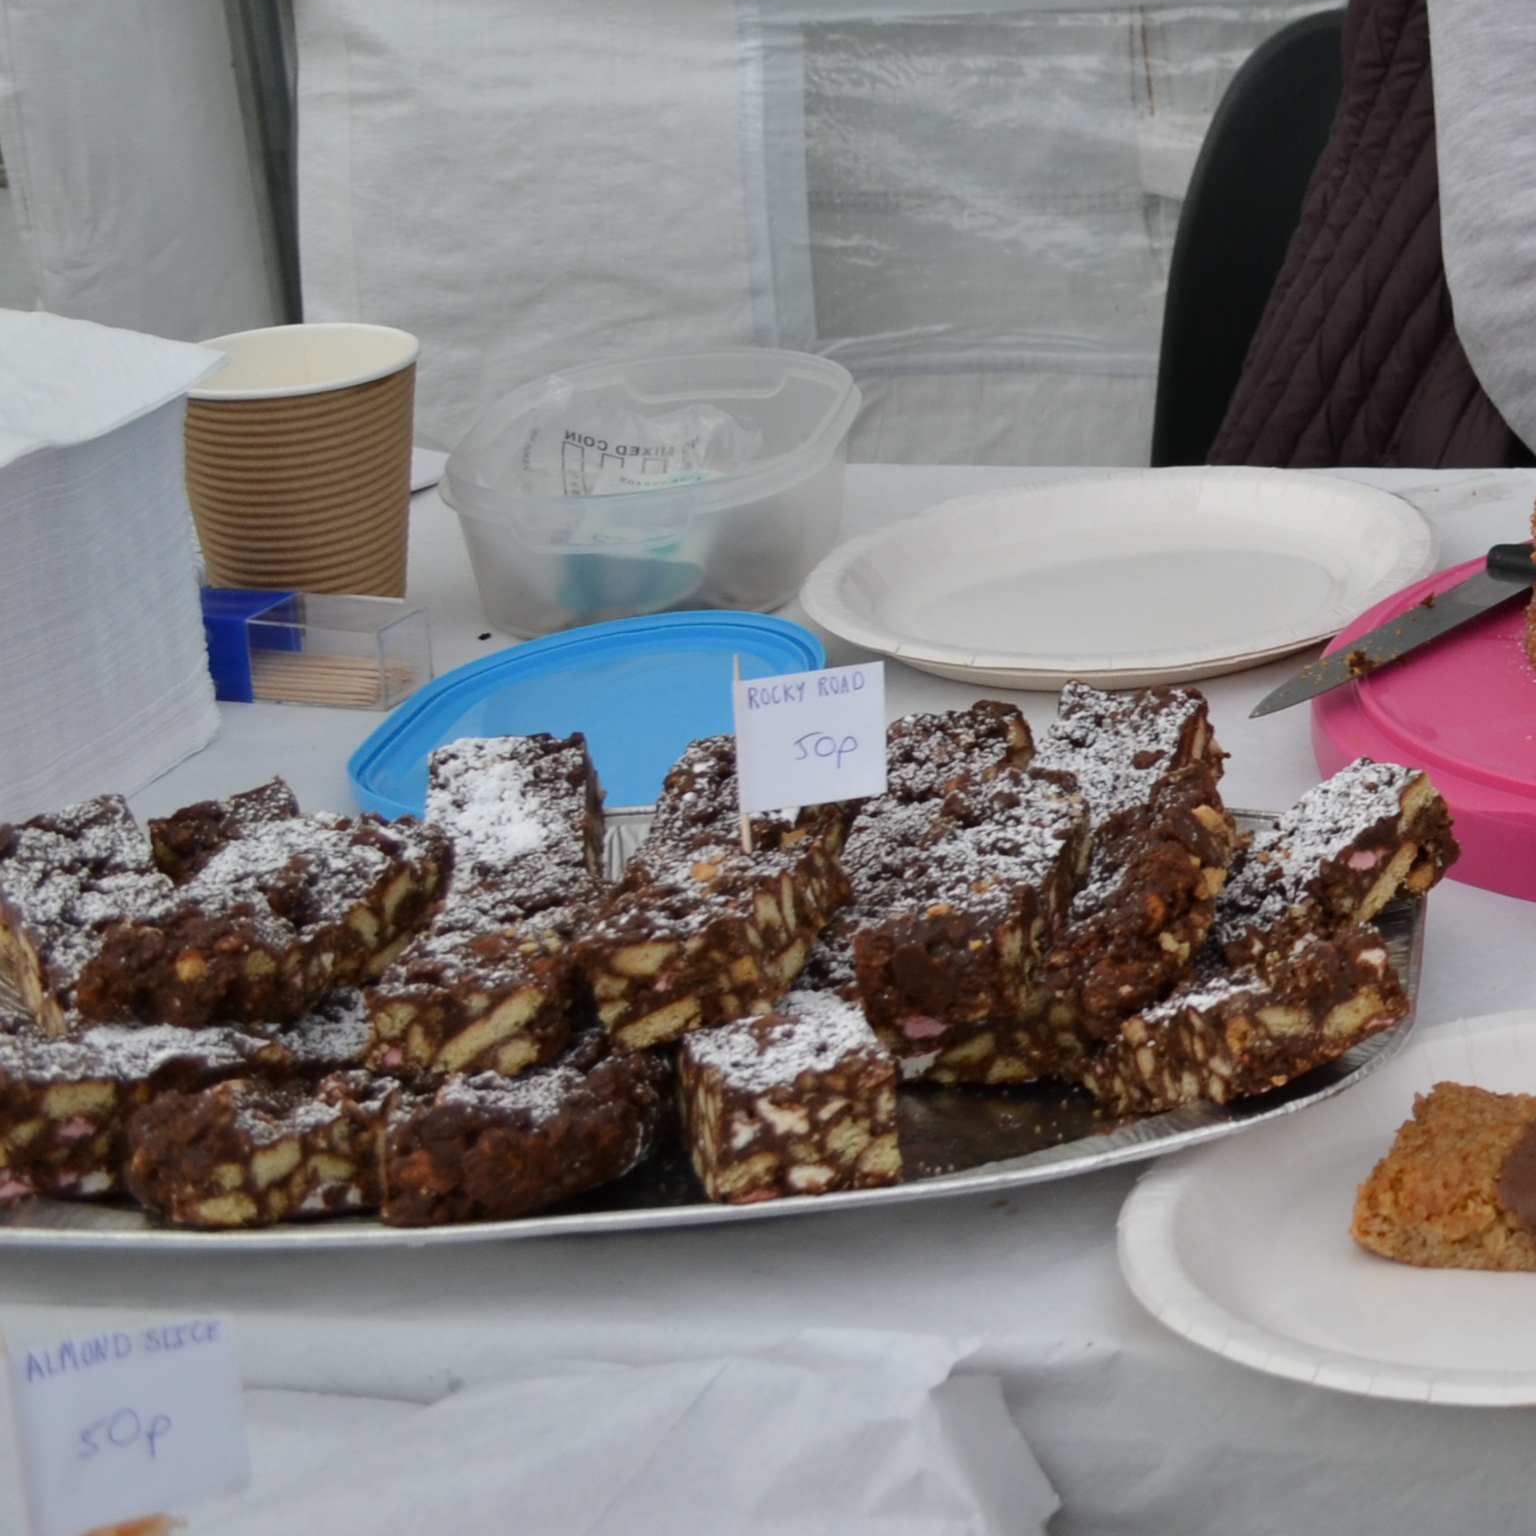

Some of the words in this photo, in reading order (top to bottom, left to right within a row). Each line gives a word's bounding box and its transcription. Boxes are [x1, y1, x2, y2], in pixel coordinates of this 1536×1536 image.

[747, 681, 806, 710] ROCKY
[817, 671, 866, 698] ROAD
[793, 731, 859, 769] 50p
[25, 1331, 133, 1384] ALMOND
[145, 1319, 222, 1353] SLICE
[77, 1407, 173, 1460] 50p
